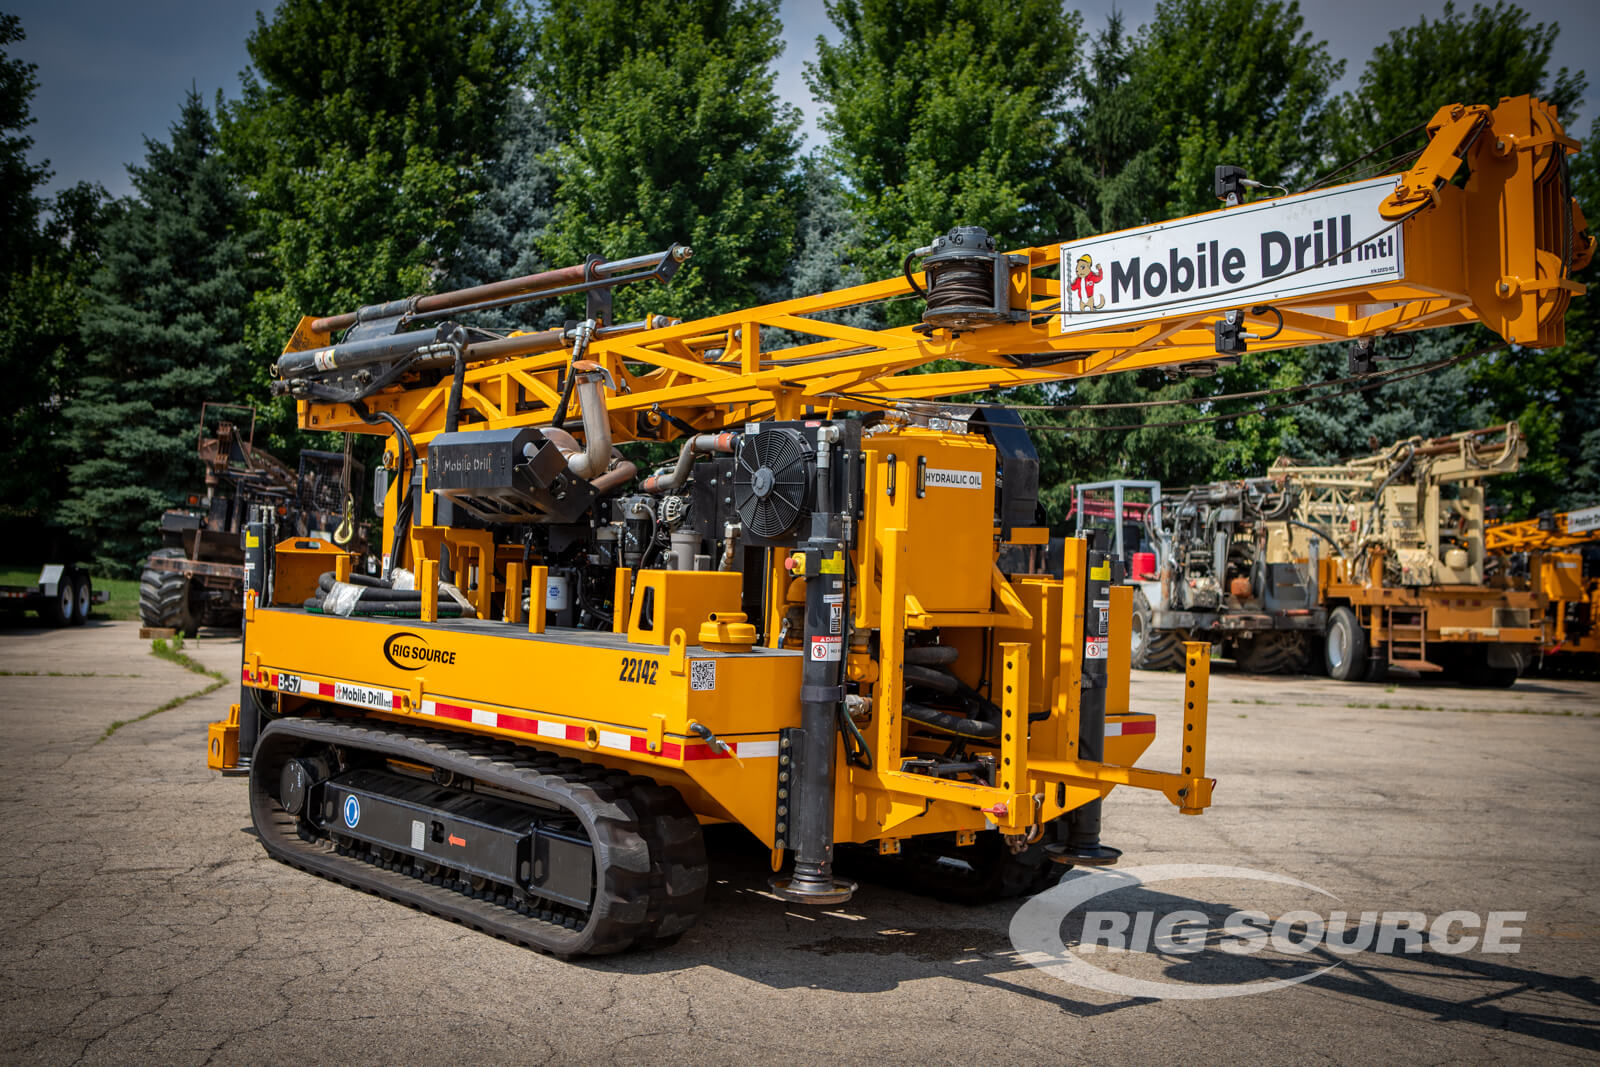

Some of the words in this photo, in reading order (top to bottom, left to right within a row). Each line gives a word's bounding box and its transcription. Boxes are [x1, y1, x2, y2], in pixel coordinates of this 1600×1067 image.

[1111, 240, 1246, 304] Mobile
[1261, 214, 1352, 279] Drill
[1357, 235, 1393, 262] Intl
[444, 457, 471, 472] Mobile
[473, 457, 491, 471] Drill
[925, 472, 967, 485] HYDRAULIC
[969, 475, 982, 486] OIL
[392, 643, 410, 658] RIG
[411, 646, 456, 665] SOURCE
[619, 657, 659, 685] 22142
[278, 673, 301, 693] B-57
[341, 686, 366, 703] Mobile
[368, 691, 384, 707] Drill
